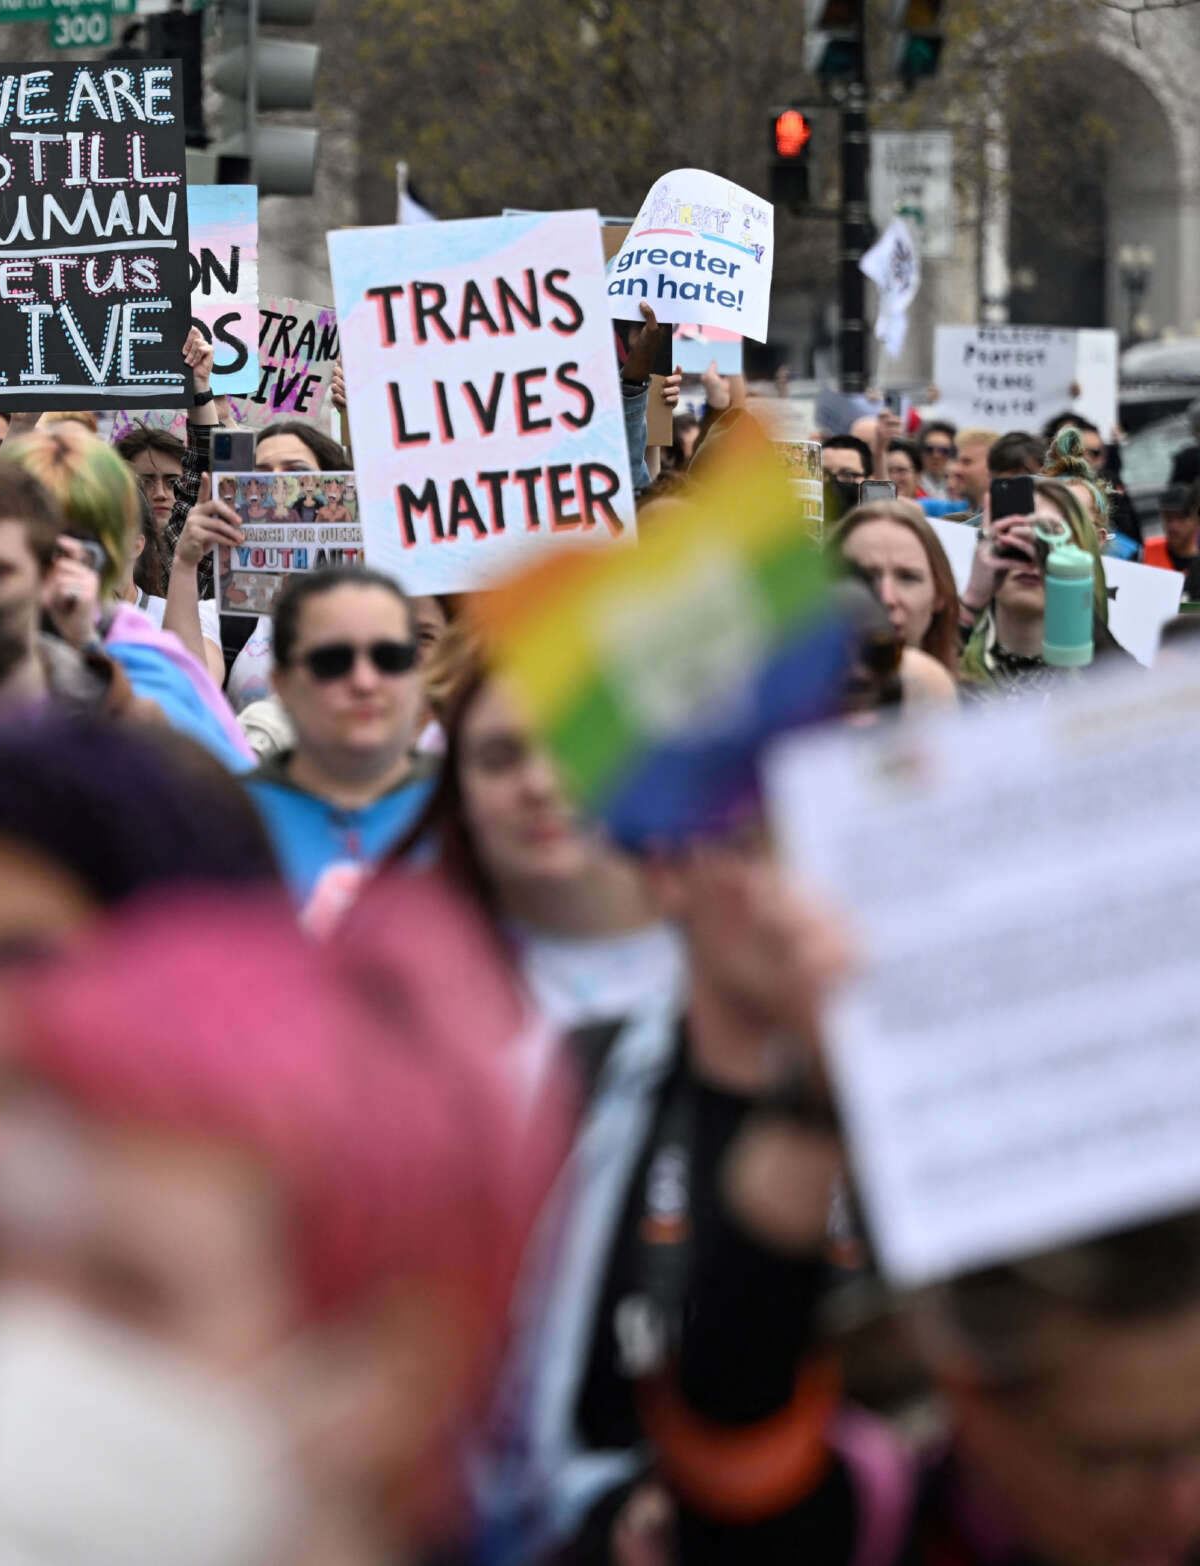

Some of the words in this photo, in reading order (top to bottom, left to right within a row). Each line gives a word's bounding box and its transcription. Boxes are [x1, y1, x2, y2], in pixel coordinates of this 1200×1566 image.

[54, 13, 106, 45] 300
[66, 67, 176, 124] ARE
[616, 248, 741, 279] greater
[365, 268, 584, 347] TRANS
[607, 277, 648, 298] an
[657, 273, 745, 312] hate!
[258, 309, 340, 362] TRAN
[227, 365, 322, 412] IVE
[387, 362, 596, 450] LIVES
[395, 462, 625, 548] MATTER
[237, 548, 308, 569] YOUTH
[288, 528, 315, 542] FOR
[318, 528, 363, 543] QUEER
